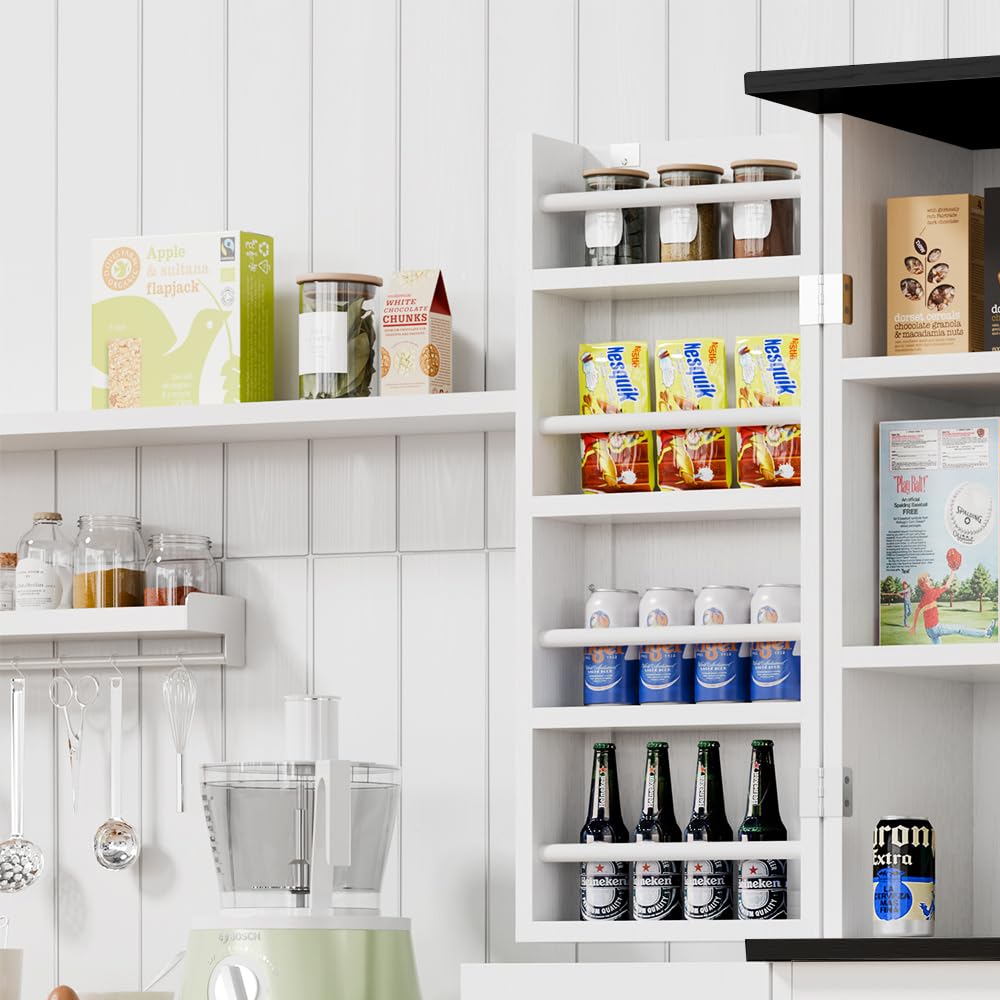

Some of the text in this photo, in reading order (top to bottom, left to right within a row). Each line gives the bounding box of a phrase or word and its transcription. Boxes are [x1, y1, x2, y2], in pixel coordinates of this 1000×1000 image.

[147, 245, 185, 262] Apple
[146, 280, 200, 297] flapjack
[386, 298, 417, 306] WHITE
[383, 313, 428, 324] CHUNKS
[894, 320, 962, 331] chocolate granola
[903, 329, 945, 338] macadamia
[947, 328, 964, 336] nuts
[607, 346, 640, 402] Nesquik
[684, 342, 717, 399] Nesquik
[764, 338, 797, 395] Nesquik
[956, 505, 982, 525] SPALDING
[647, 775, 655, 807] Heineken
[751, 771, 760, 805] Heineken
